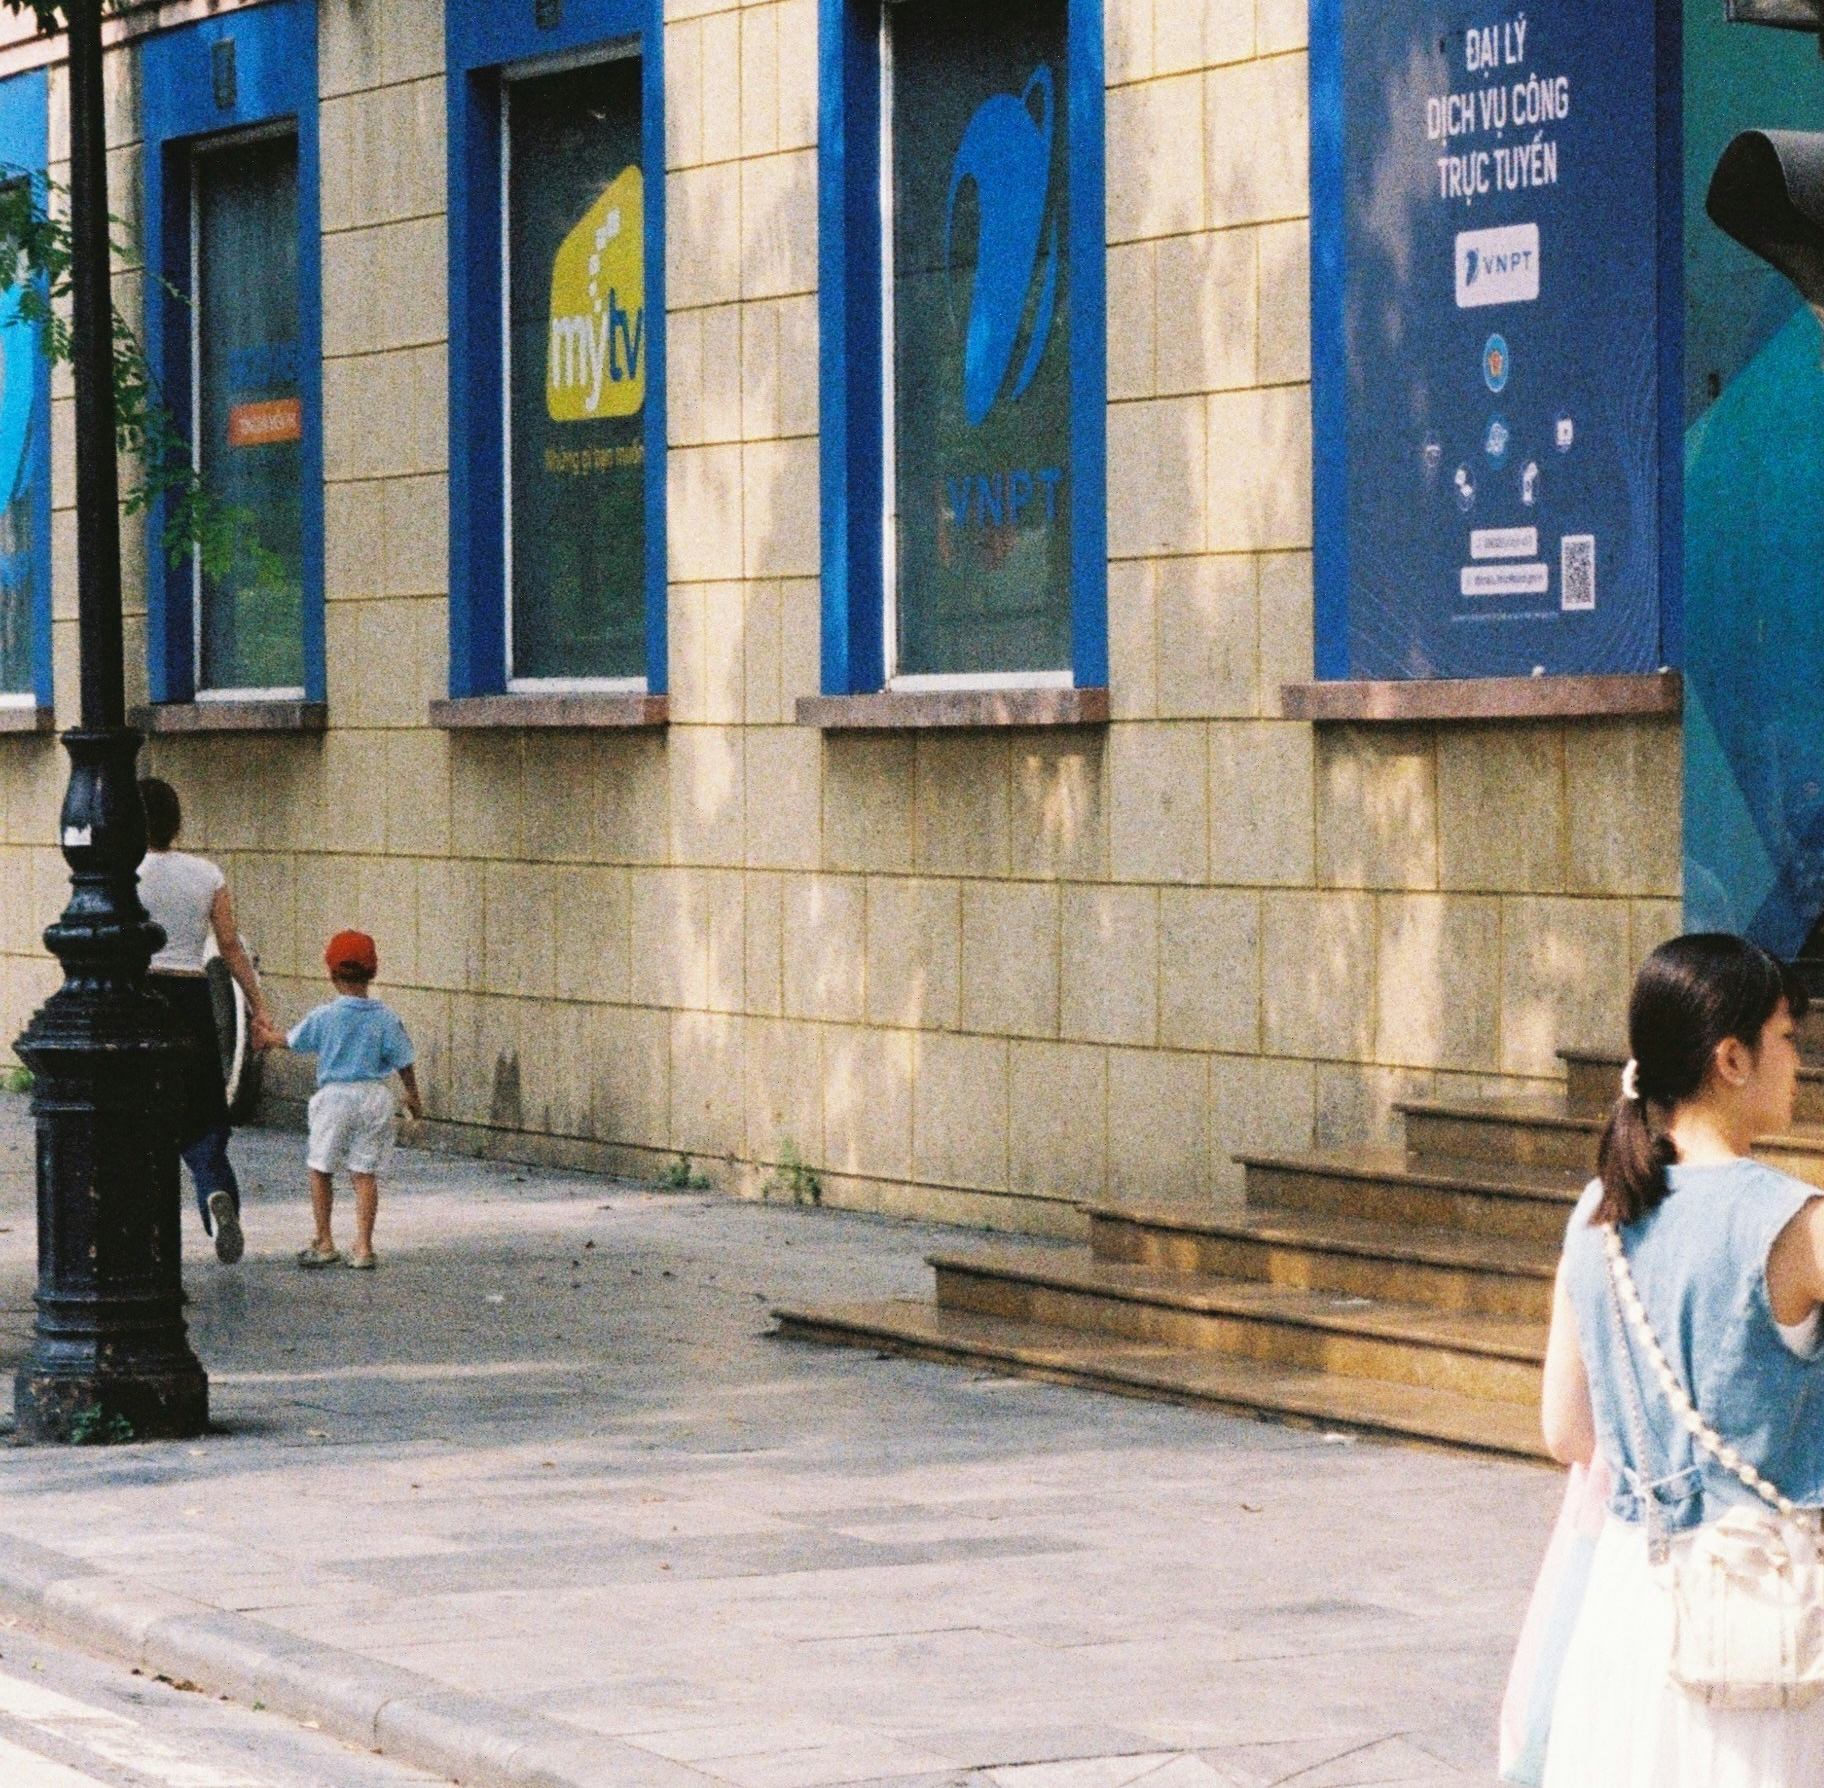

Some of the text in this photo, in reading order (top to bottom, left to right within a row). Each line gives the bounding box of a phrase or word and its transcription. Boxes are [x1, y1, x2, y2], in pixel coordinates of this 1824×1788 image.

[1465, 24, 1500, 79] ĐẠI
[1427, 72, 1570, 147] DỊCH VỤ CÔNG
[1438, 129, 1558, 206] TRỰC TUYẾN
[1481, 250, 1533, 275] VNPT
[946, 465, 1062, 530] VNPT
